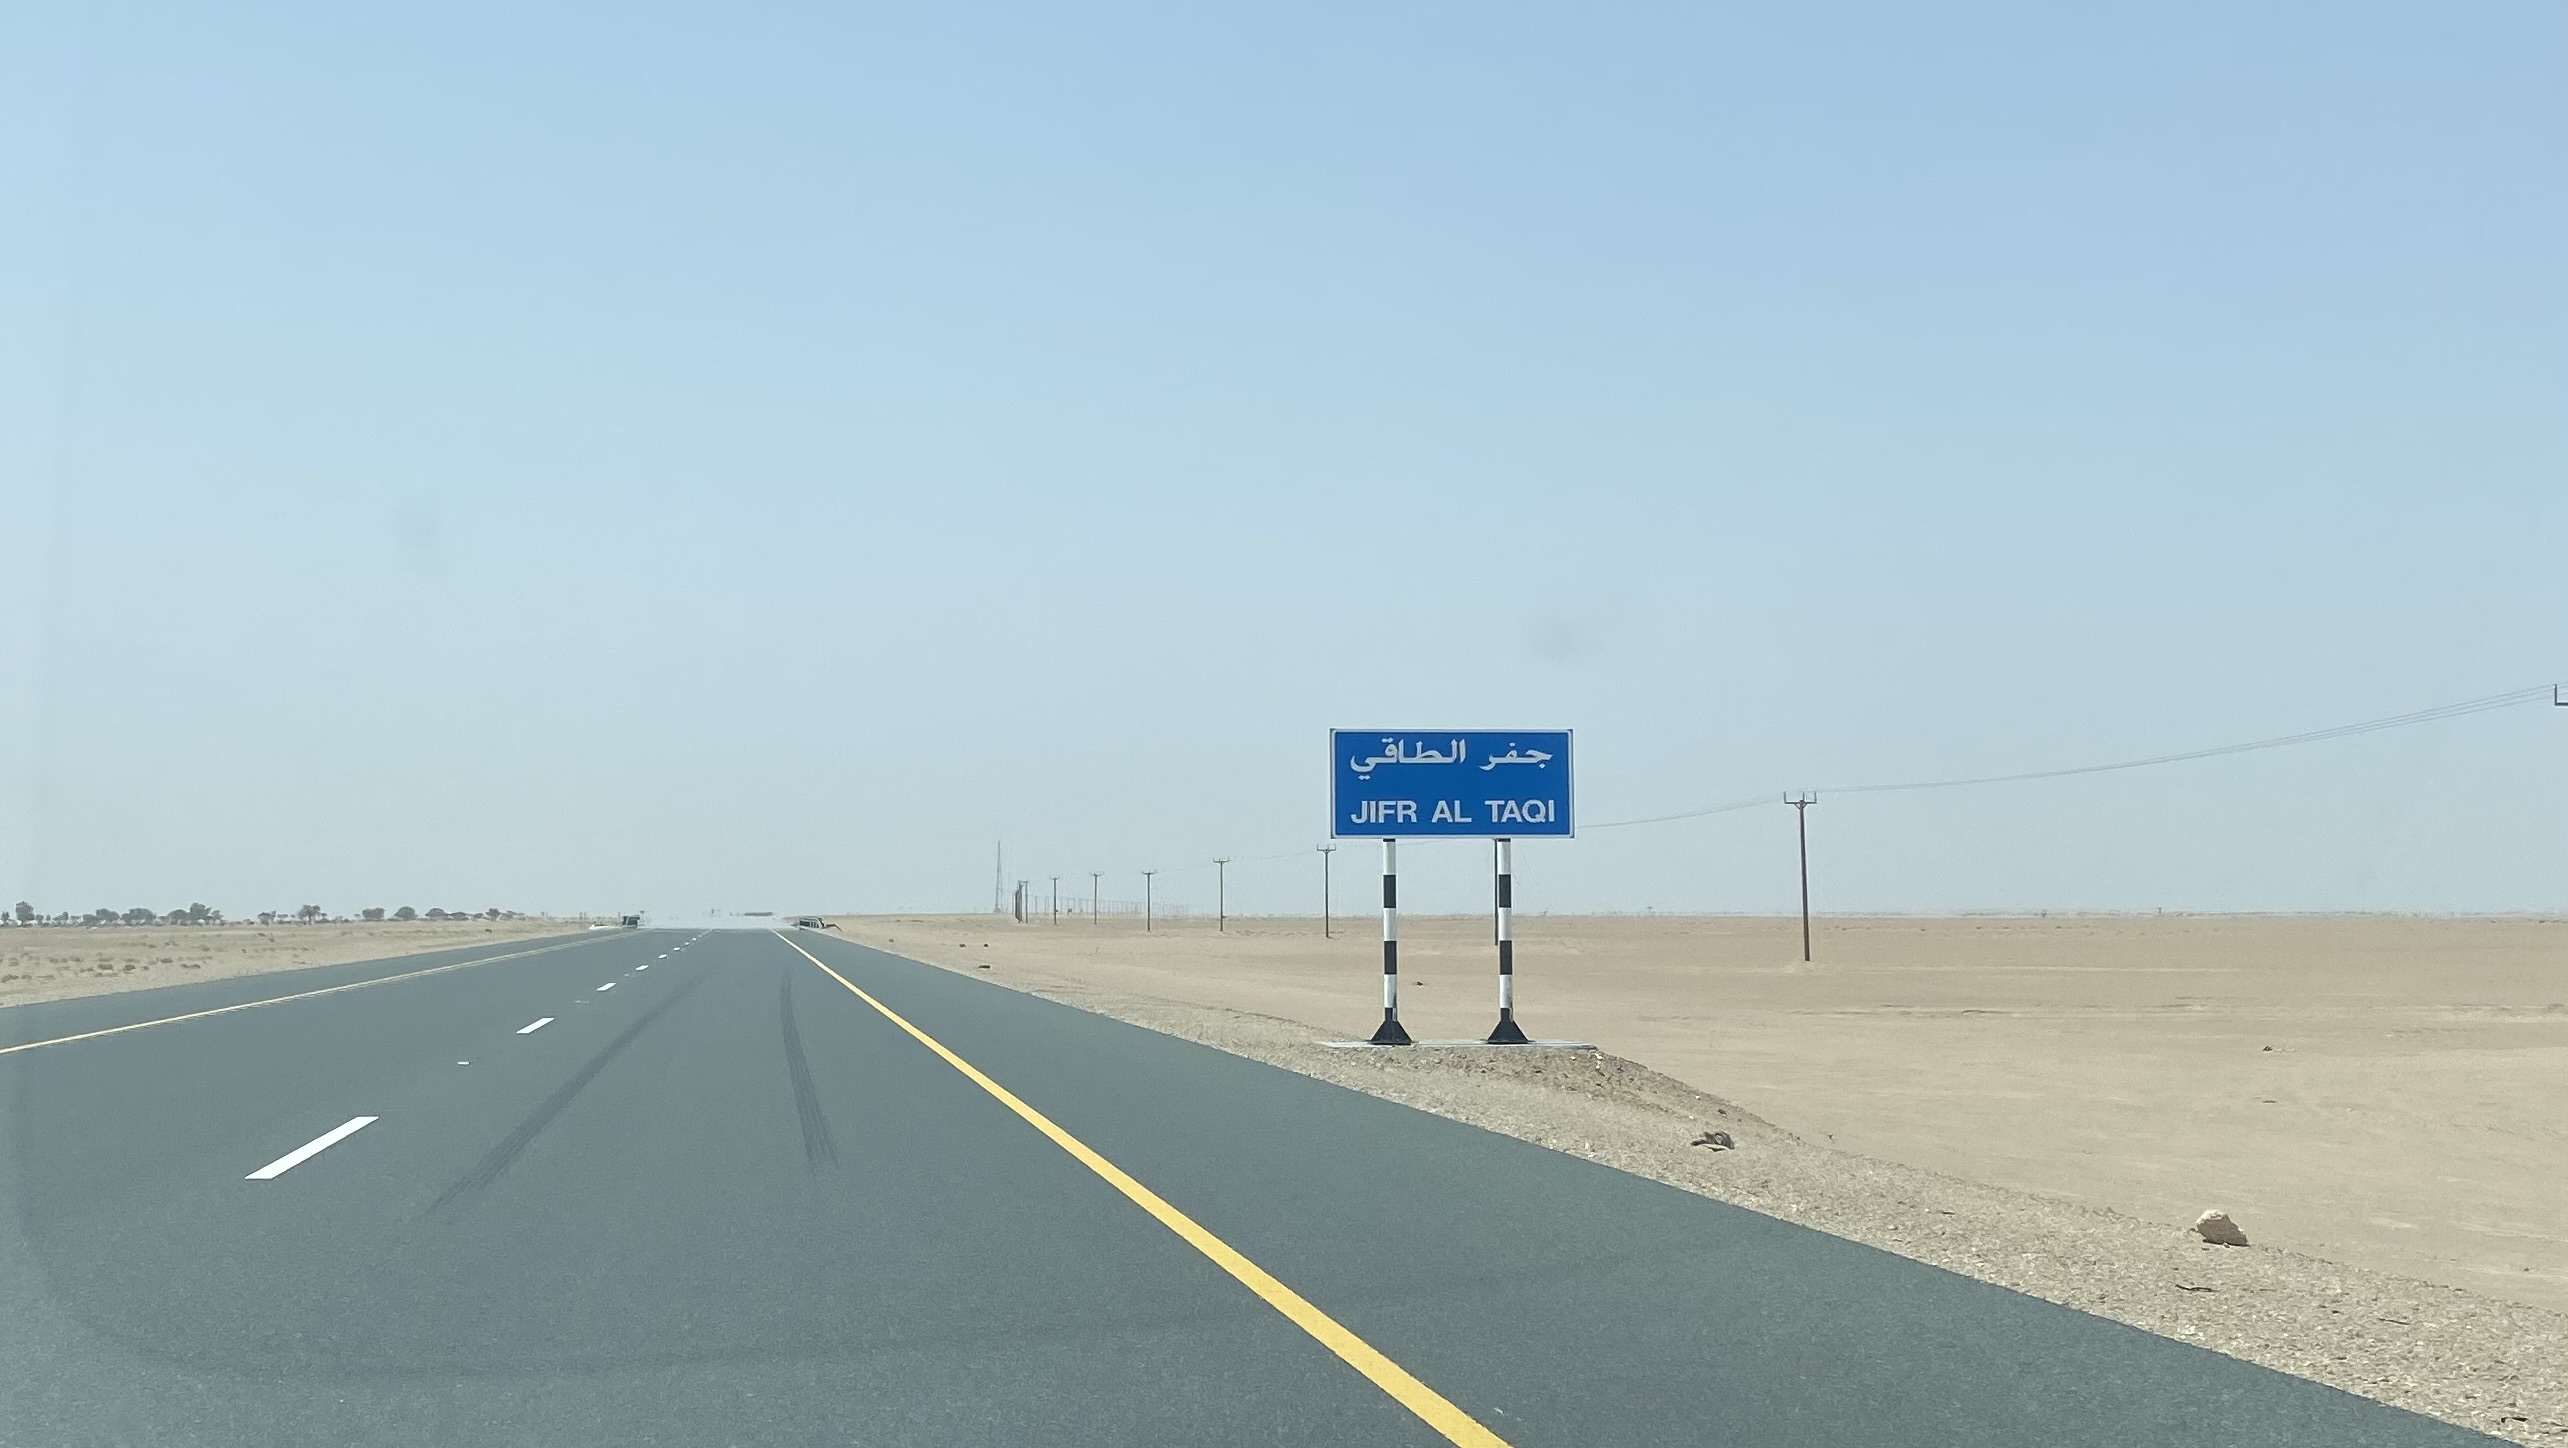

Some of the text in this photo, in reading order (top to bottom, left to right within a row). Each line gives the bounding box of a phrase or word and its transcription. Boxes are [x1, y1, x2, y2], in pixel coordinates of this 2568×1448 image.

[1350, 737, 1554, 780] جفر الطاقي
[1350, 799, 1556, 824] JIFR AL TAQI
